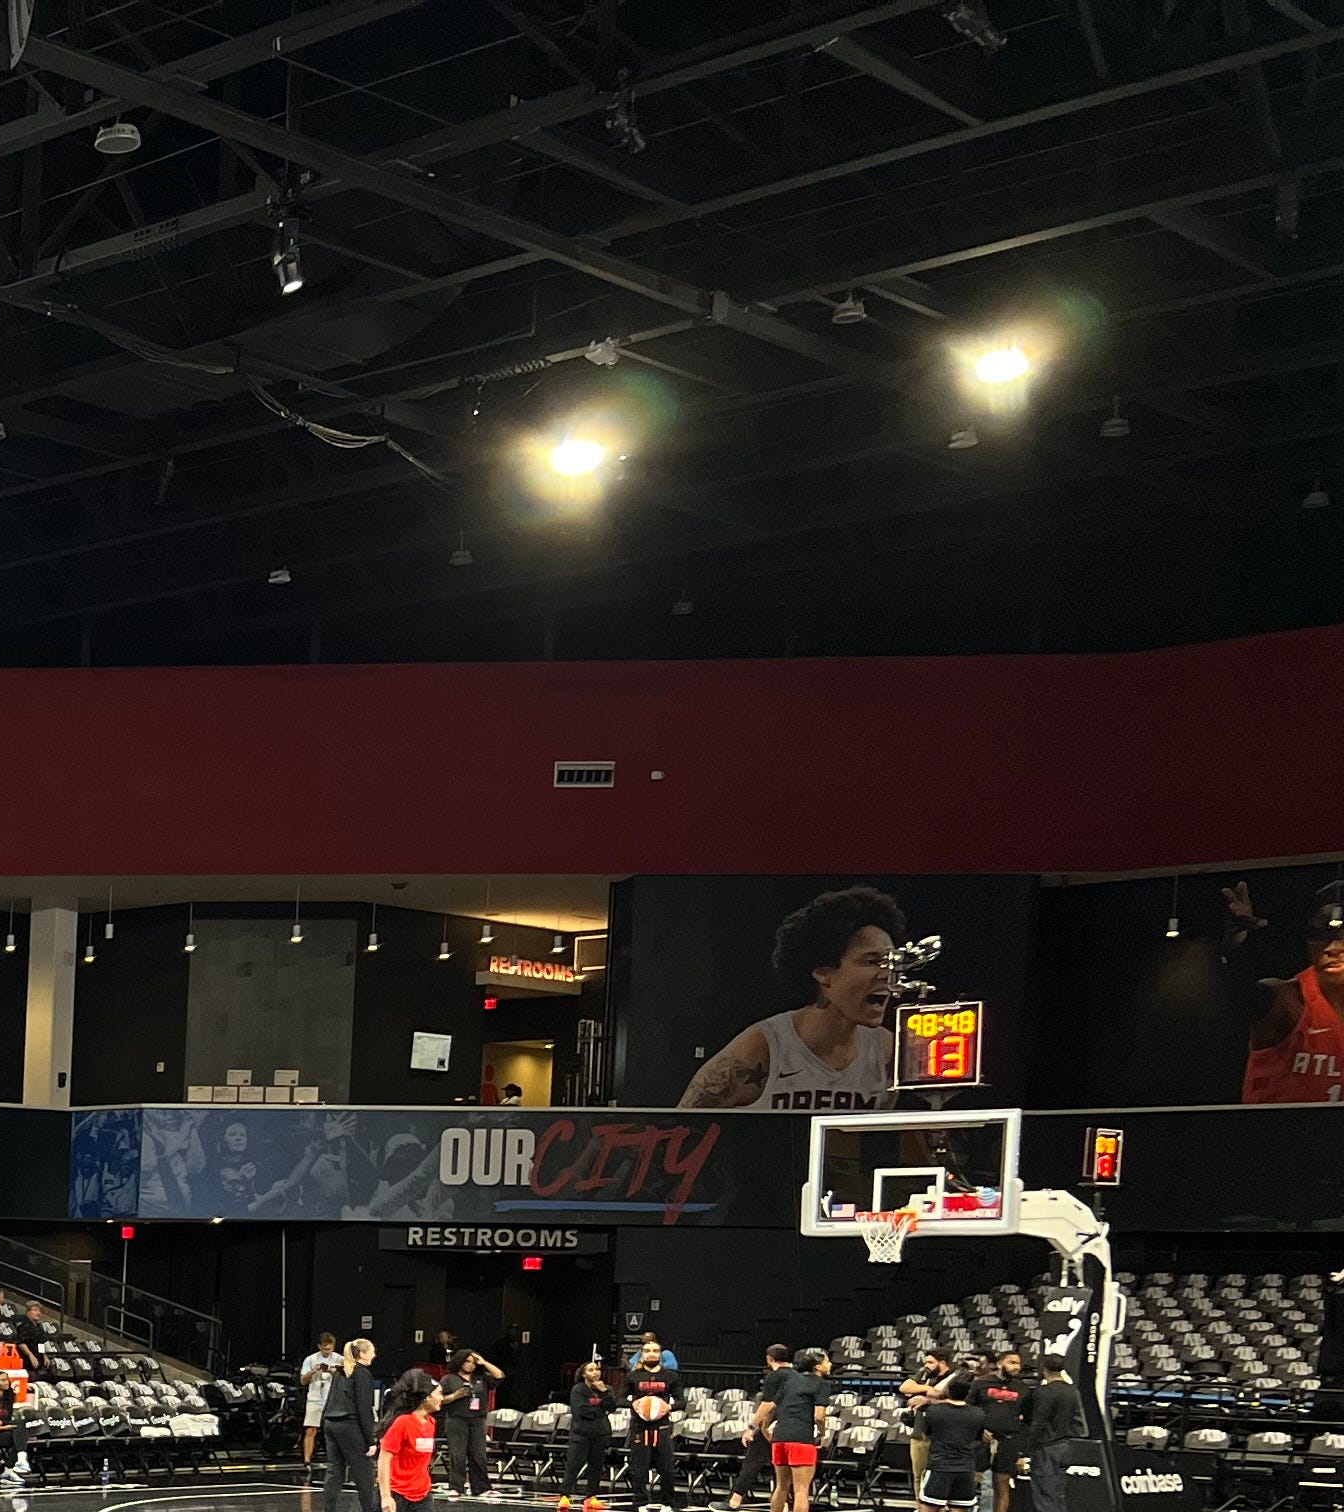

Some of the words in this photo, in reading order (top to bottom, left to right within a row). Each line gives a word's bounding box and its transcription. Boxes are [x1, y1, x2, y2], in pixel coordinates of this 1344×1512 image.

[907, 1010, 976, 1038] 98:48
[928, 1036, 968, 1078] 13
[439, 1127, 536, 1187] OUR
[529, 1119, 721, 1226] CITY
[407, 1226, 580, 1248] RESTROOMS
[1047, 1297, 1085, 1315] ally
[1120, 1468, 1183, 1495] coinbase
